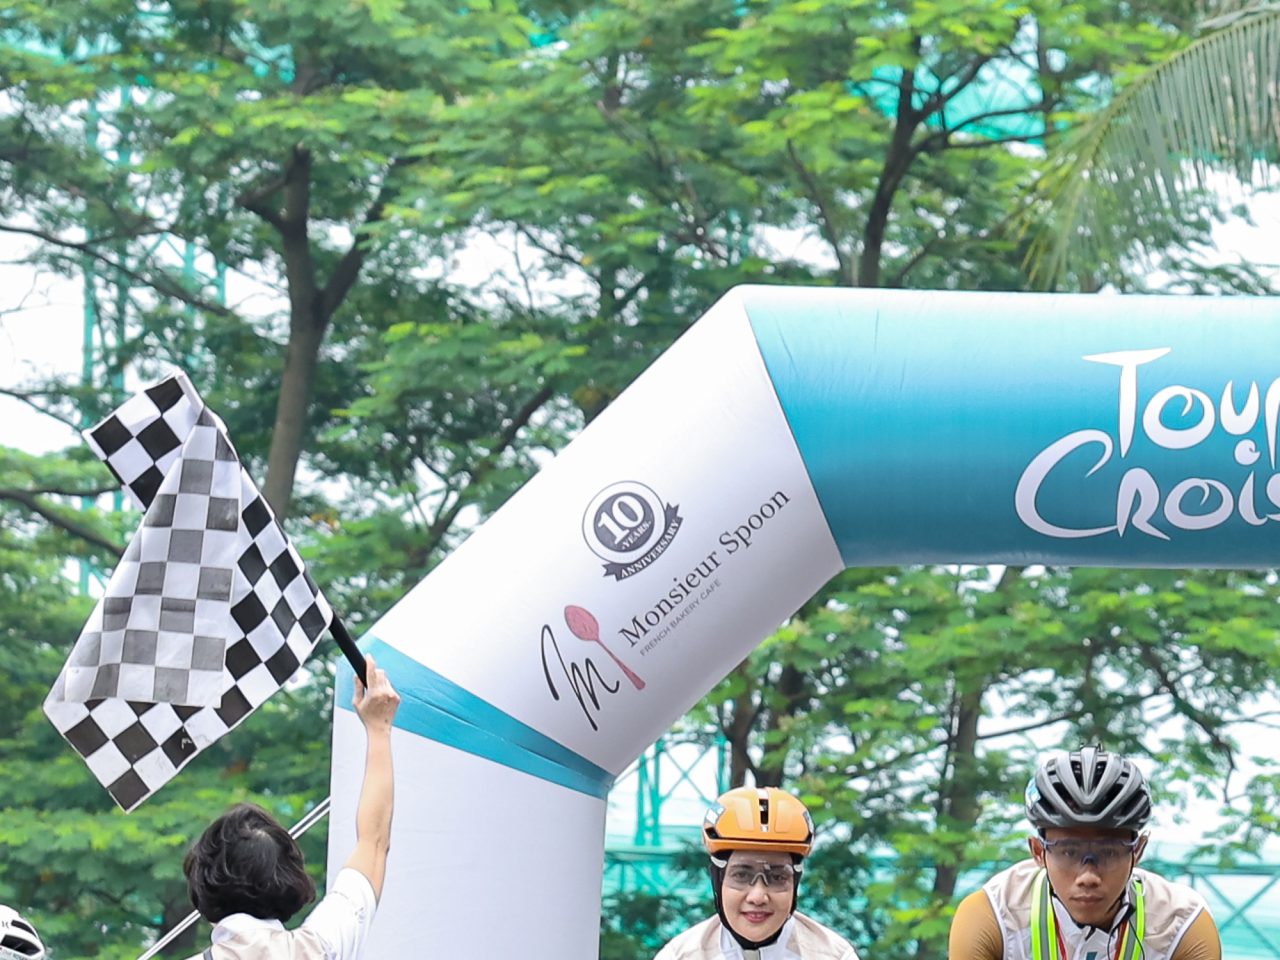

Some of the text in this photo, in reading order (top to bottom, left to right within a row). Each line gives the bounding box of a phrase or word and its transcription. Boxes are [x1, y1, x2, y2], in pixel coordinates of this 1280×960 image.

[597, 495, 645, 545] 10
[620, 519, 680, 579] ANNIVERSARY
[623, 522, 650, 549] YEARS
[617, 489, 792, 648] Monsieur Spoon
[639, 578, 723, 657] FRENCH BAKERY CAFE
